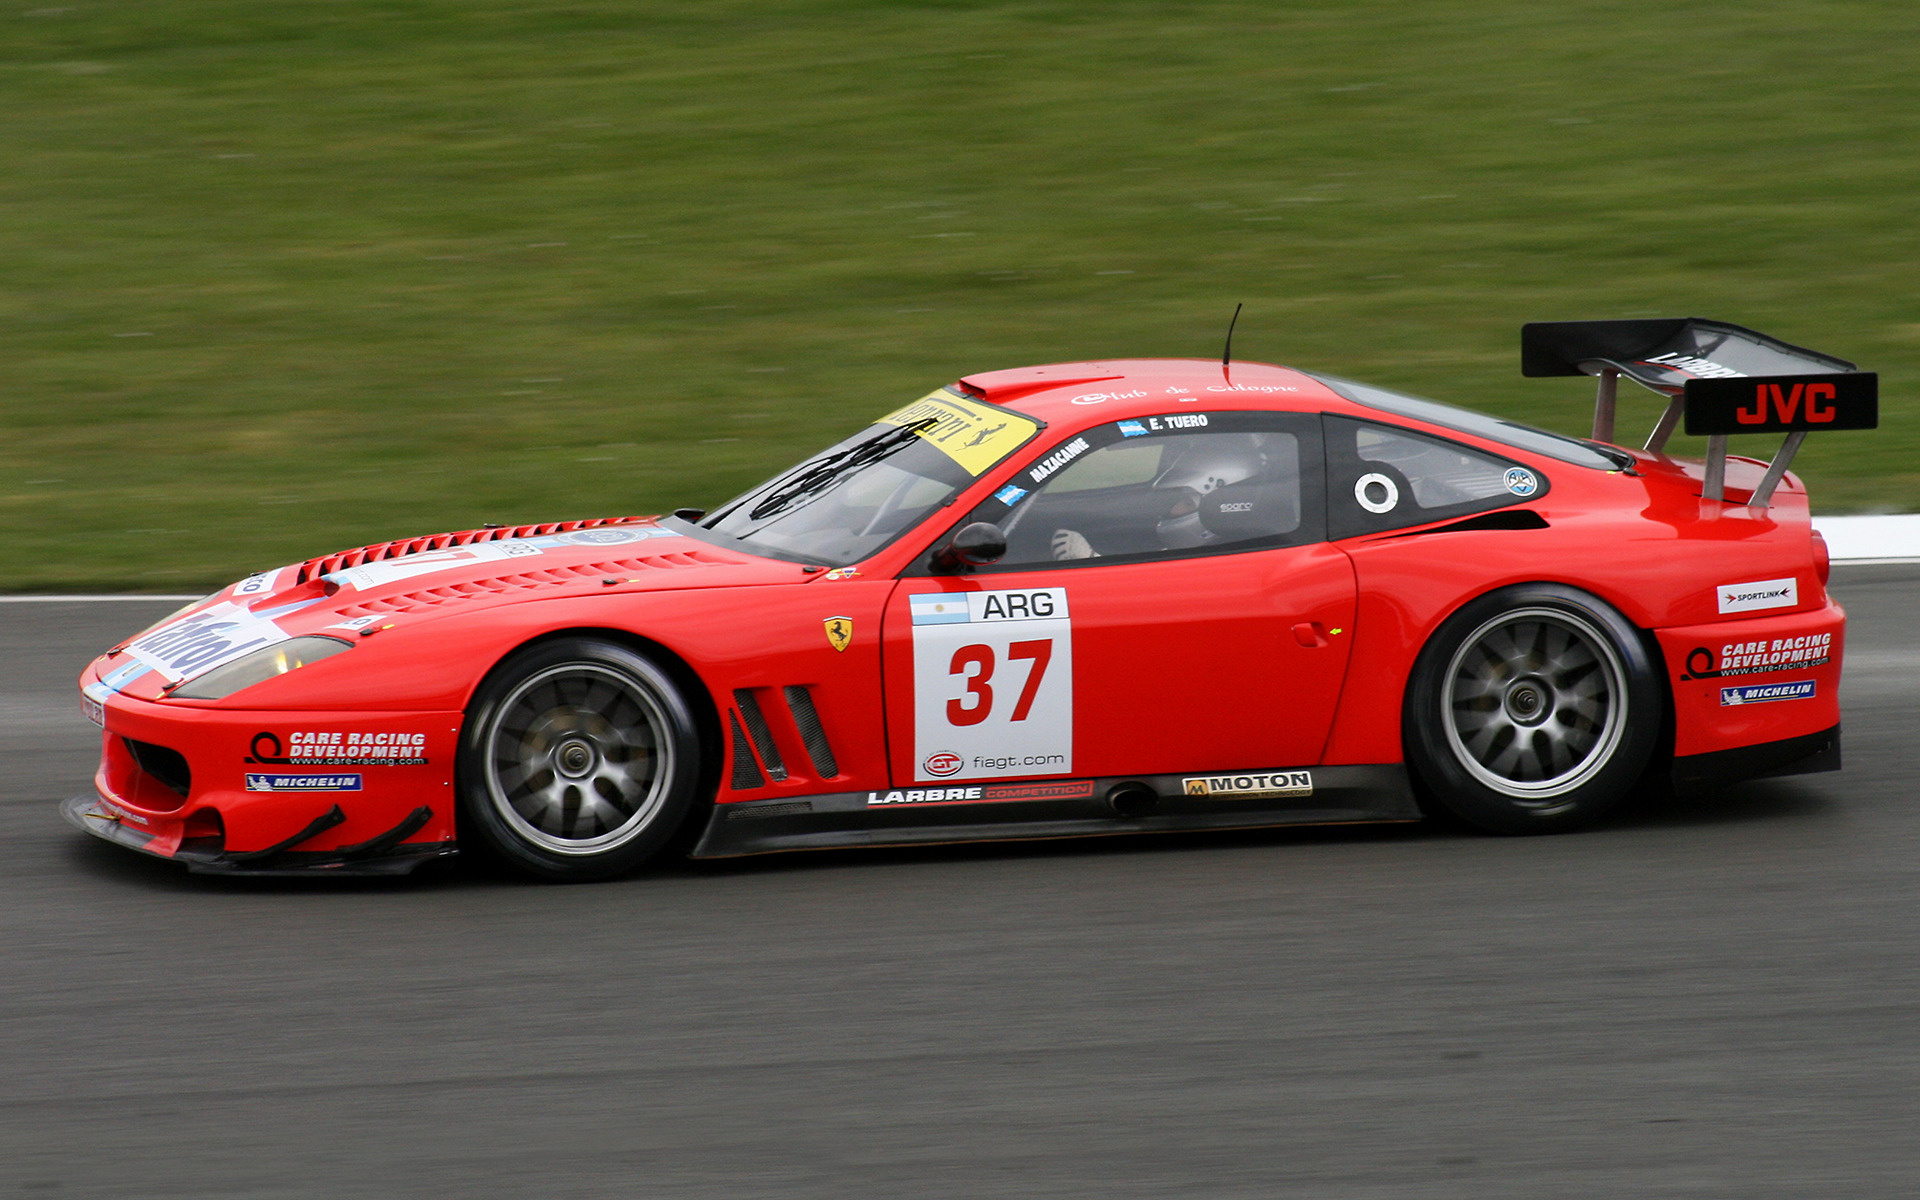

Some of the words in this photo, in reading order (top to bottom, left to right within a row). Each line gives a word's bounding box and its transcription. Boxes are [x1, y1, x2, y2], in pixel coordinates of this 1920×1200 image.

[1165, 386, 1190, 394] de
[1206, 383, 1298, 393] Cologne
[1736, 383, 1836, 425] JVC
[1149, 418, 1163, 431] E.
[1164, 414, 1209, 430] TUERO
[1029, 437, 1090, 483] MAZACANNE
[1737, 590, 1781, 602] SPORTLINK
[983, 592, 1054, 620] ARG
[1721, 640, 1768, 657] CARE
[1771, 632, 1832, 652] RACING
[1720, 645, 1830, 670] DEVELOPMENT
[1720, 657, 1829, 677] www.care-racing.com
[946, 638, 1053, 727] 37
[1745, 684, 1812, 699] MICHELIN
[289, 732, 343, 745] CARE
[347, 733, 425, 745] RACING
[289, 745, 425, 758] DEVELOPMENT
[289, 757, 425, 766] www.care-racing.com
[973, 754, 1064, 769] fiagt.com
[273, 777, 356, 787] MICHELIN
[1210, 773, 1310, 791] MOTON
[867, 787, 982, 805] LARBRE
[986, 784, 1088, 798] COMPETITION
